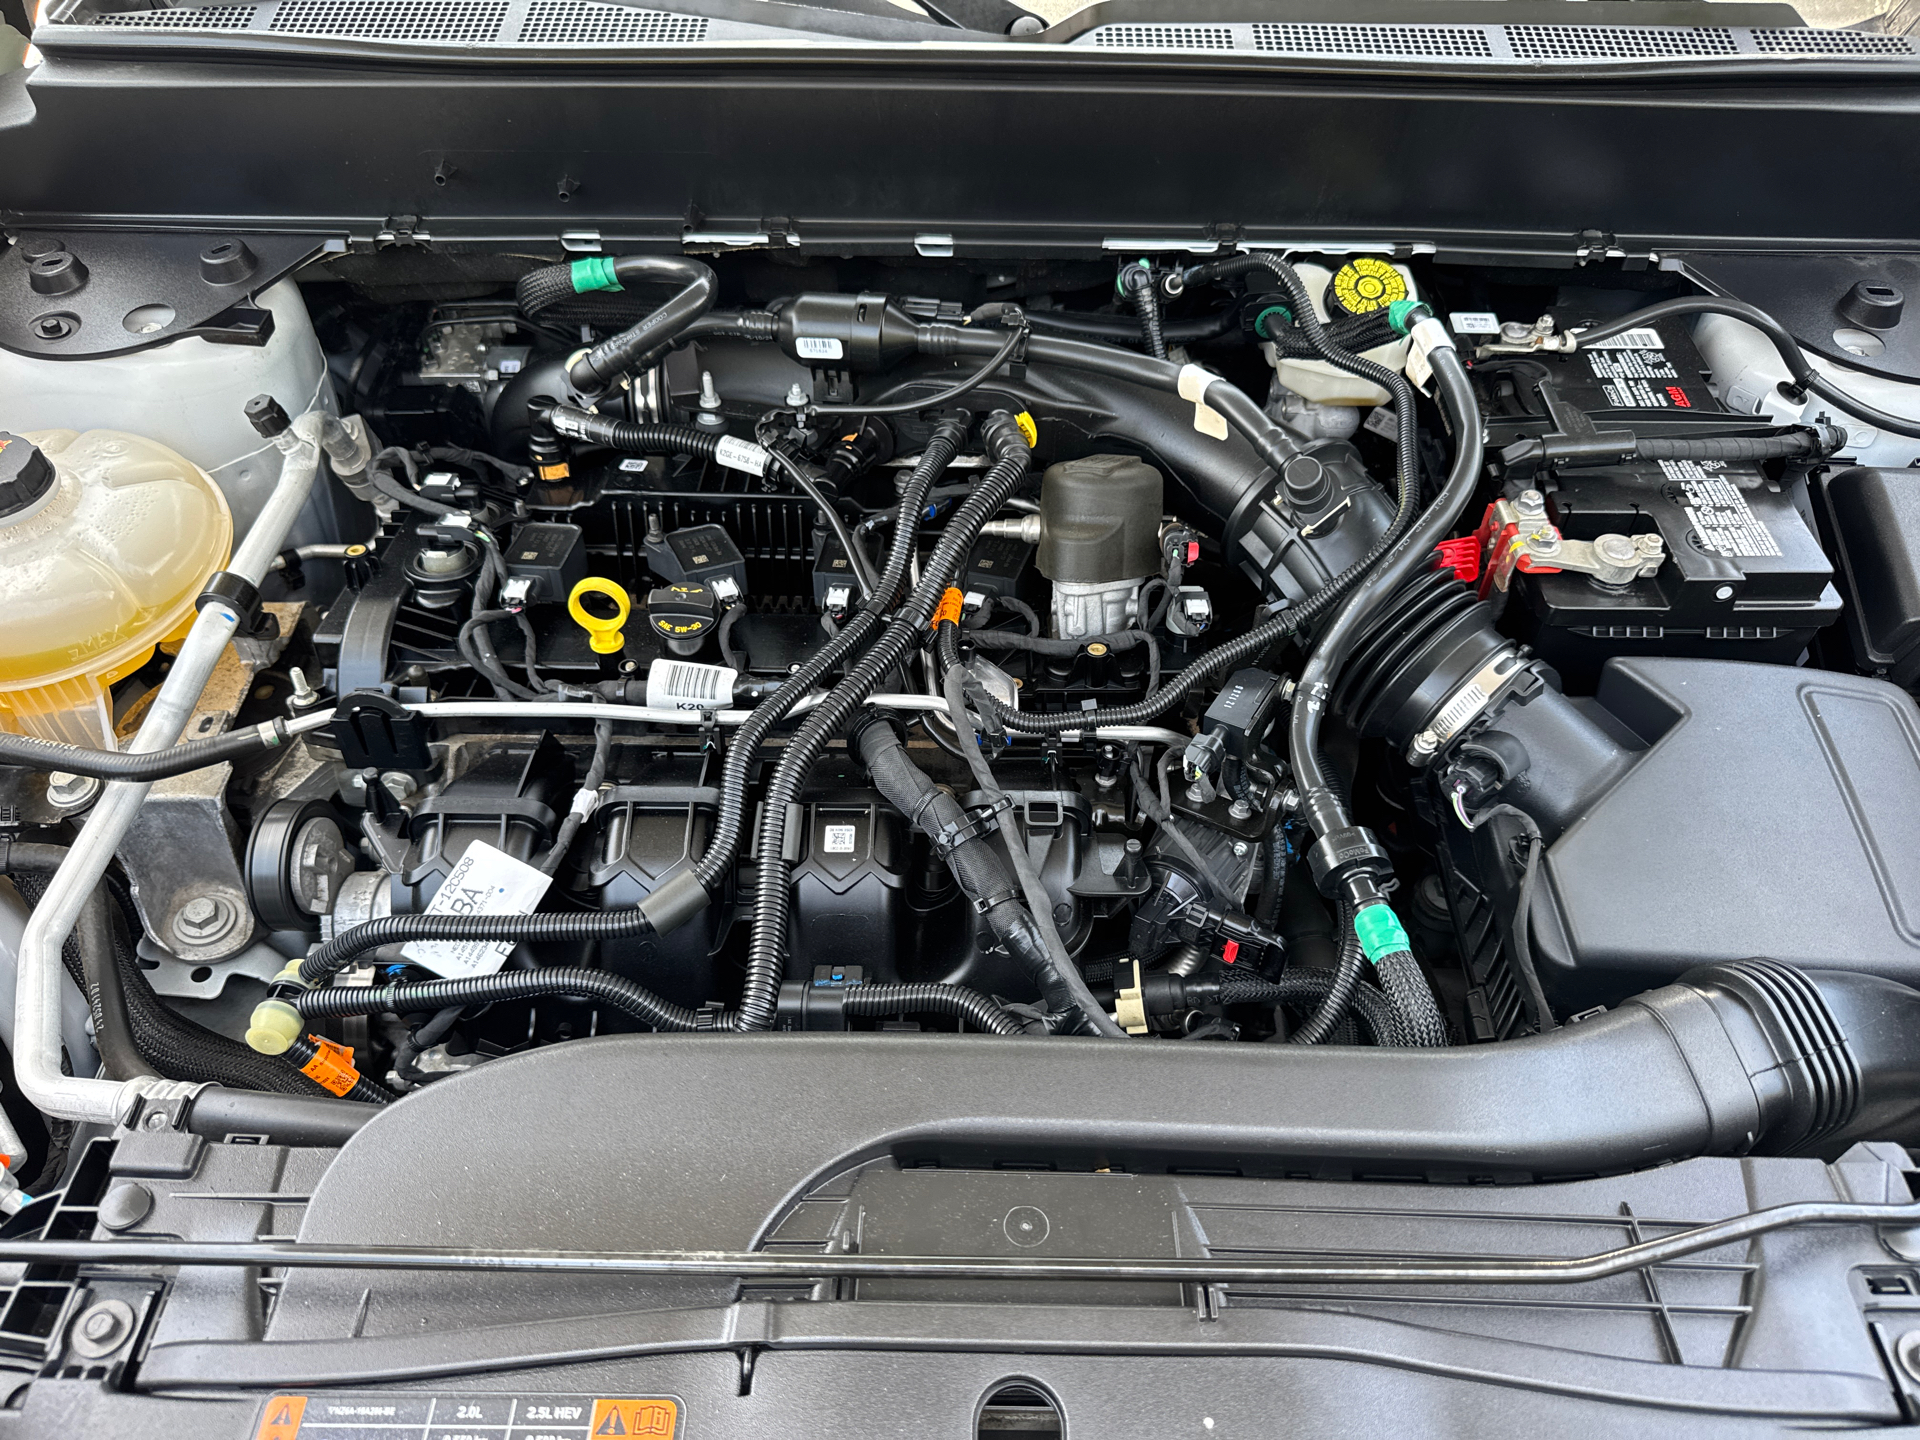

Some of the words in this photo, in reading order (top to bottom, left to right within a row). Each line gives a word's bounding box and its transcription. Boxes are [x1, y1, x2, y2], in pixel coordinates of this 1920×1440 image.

[1365, 538, 1410, 588] 04/26/24
[658, 620, 672, 632] SAE
[675, 621, 702, 633] 5W-30
[76, 622, 125, 654] MAX
[676, 702, 704, 711] K20
[1339, 847, 1370, 859] FoMoCo
[429, 856, 474, 917] T-12C508
[450, 887, 483, 916] BA
[456, 1405, 483, 1419] 2.0L
[526, 1406, 552, 1419] 2.5L
[554, 1407, 582, 1420] HEV
